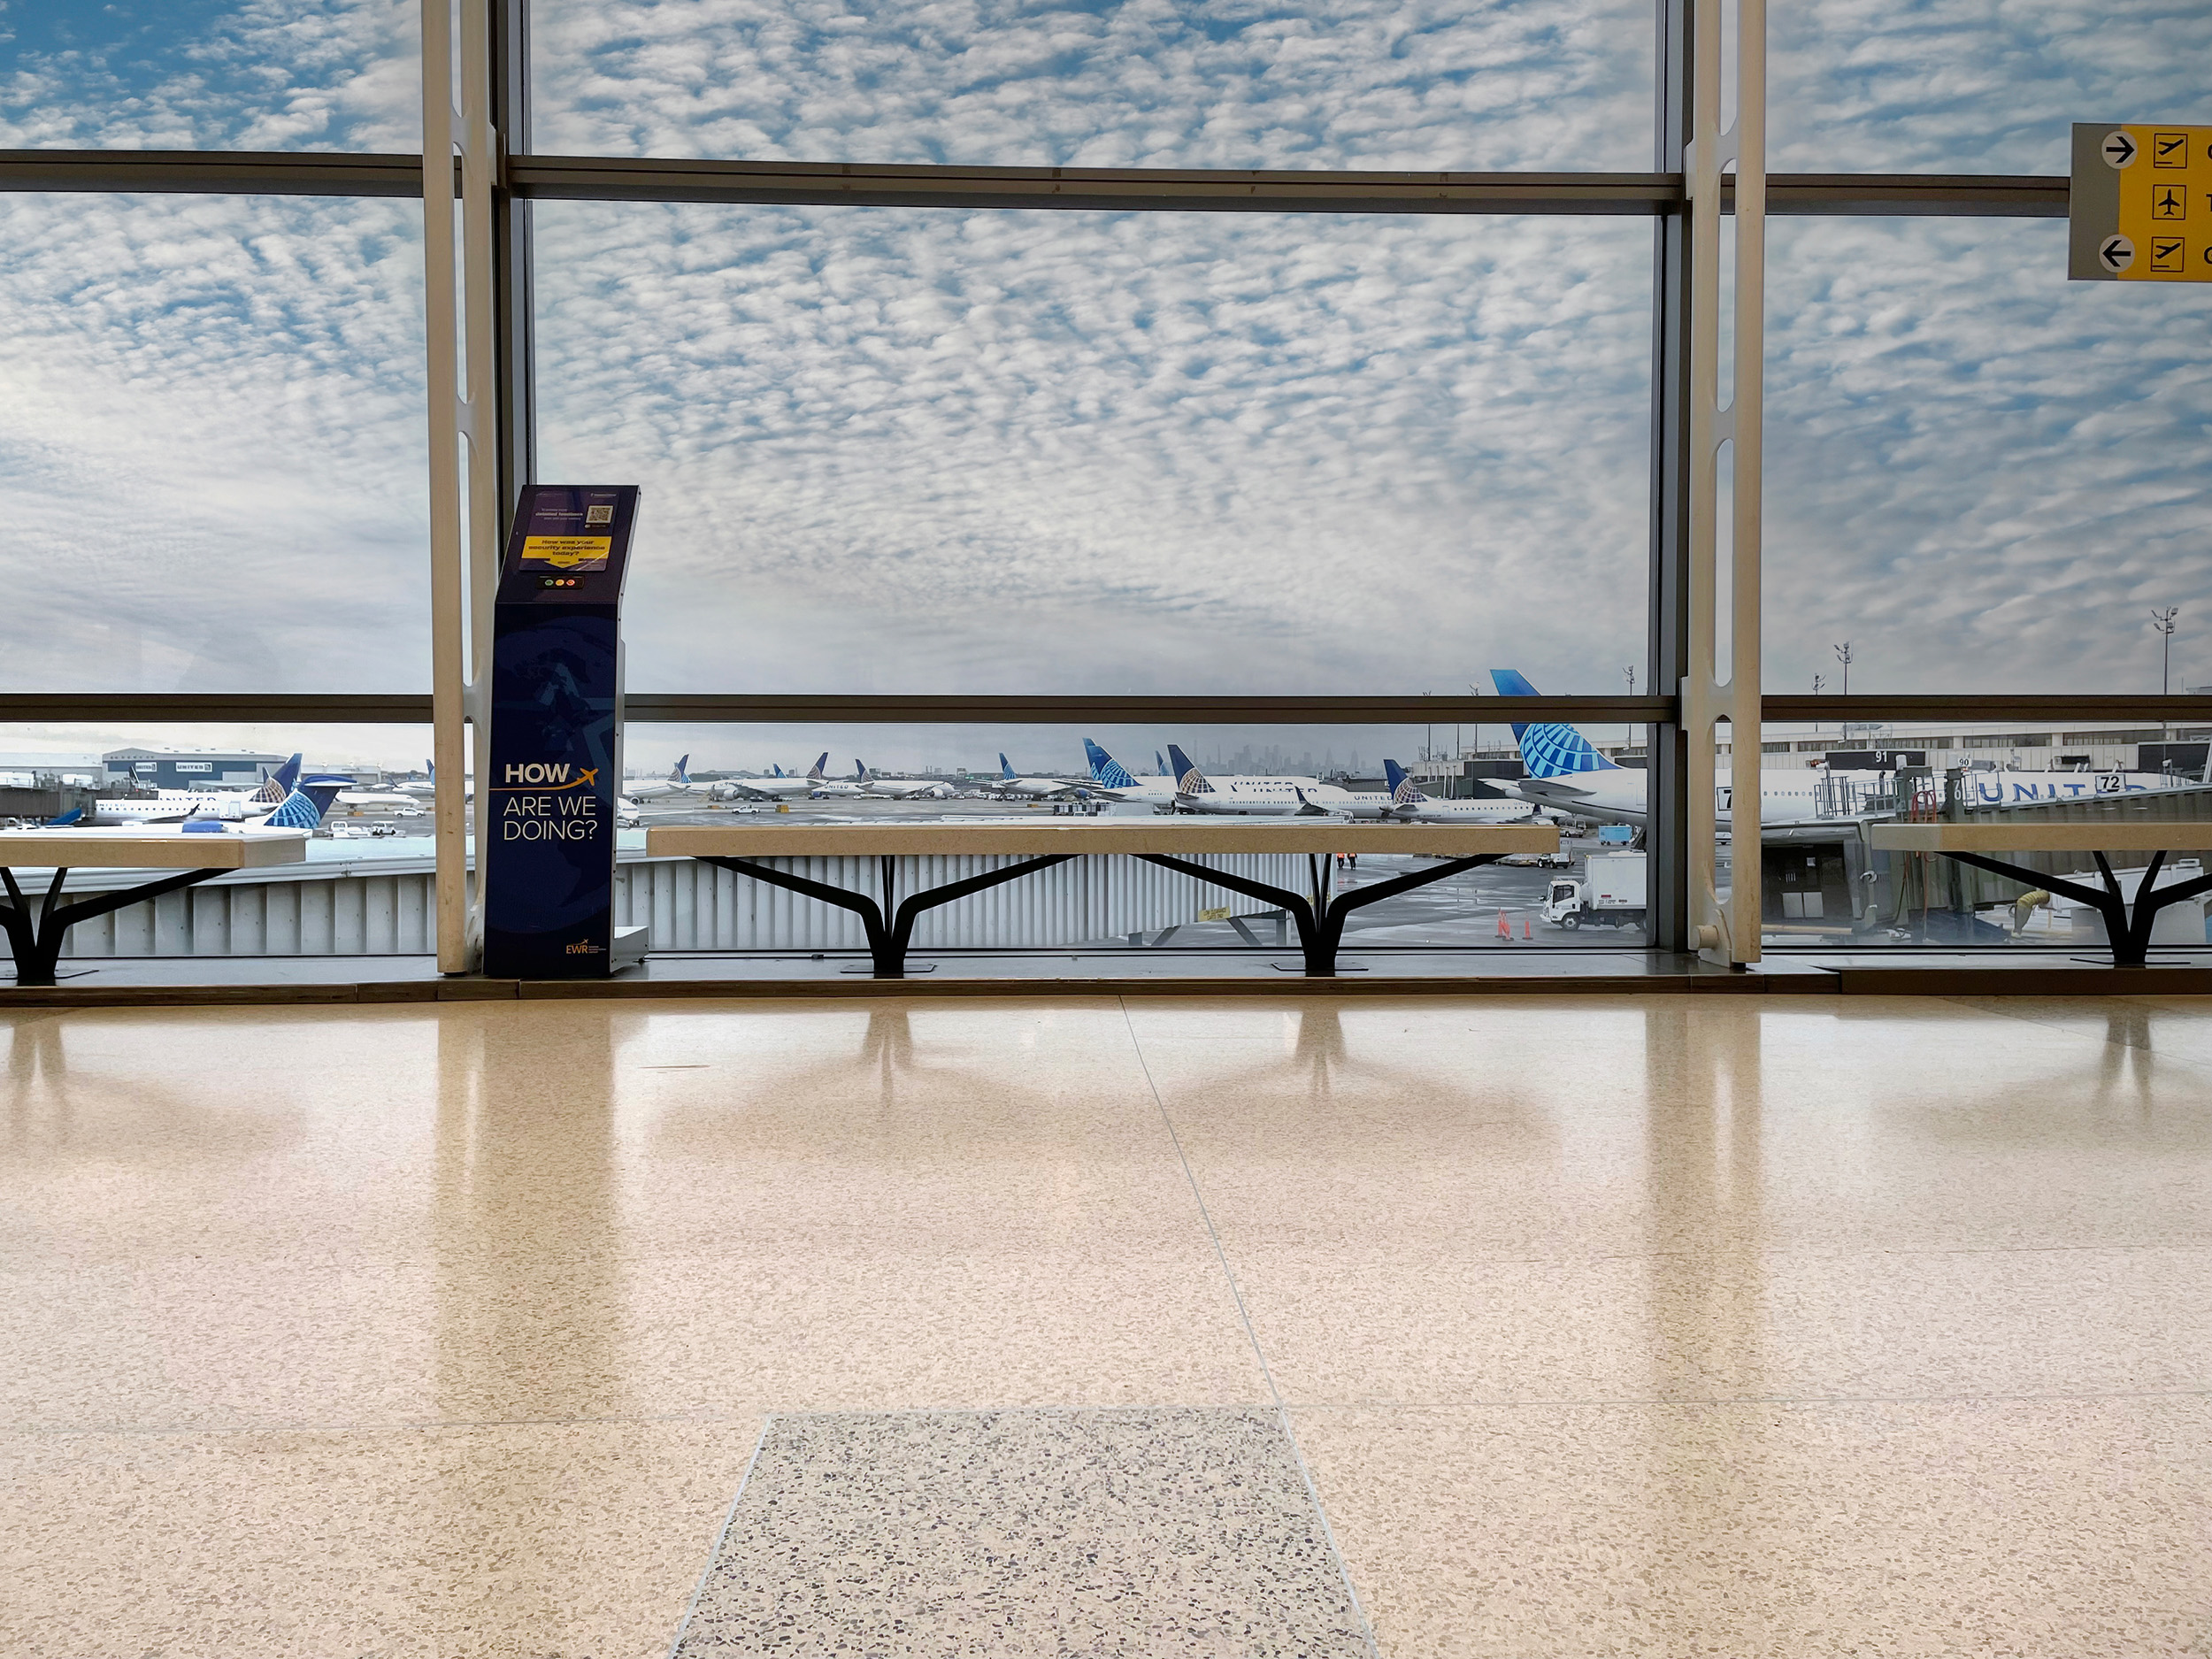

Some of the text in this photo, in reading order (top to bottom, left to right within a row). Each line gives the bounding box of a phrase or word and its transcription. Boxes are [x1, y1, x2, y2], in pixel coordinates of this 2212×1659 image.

[1876, 750, 1887, 763] 91
[505, 763, 571, 784] HOW
[2100, 776, 2120, 789] 72
[503, 796, 596, 817] ARE WE
[503, 819, 598, 841] DOING?
[565, 945, 588, 955] EWR
